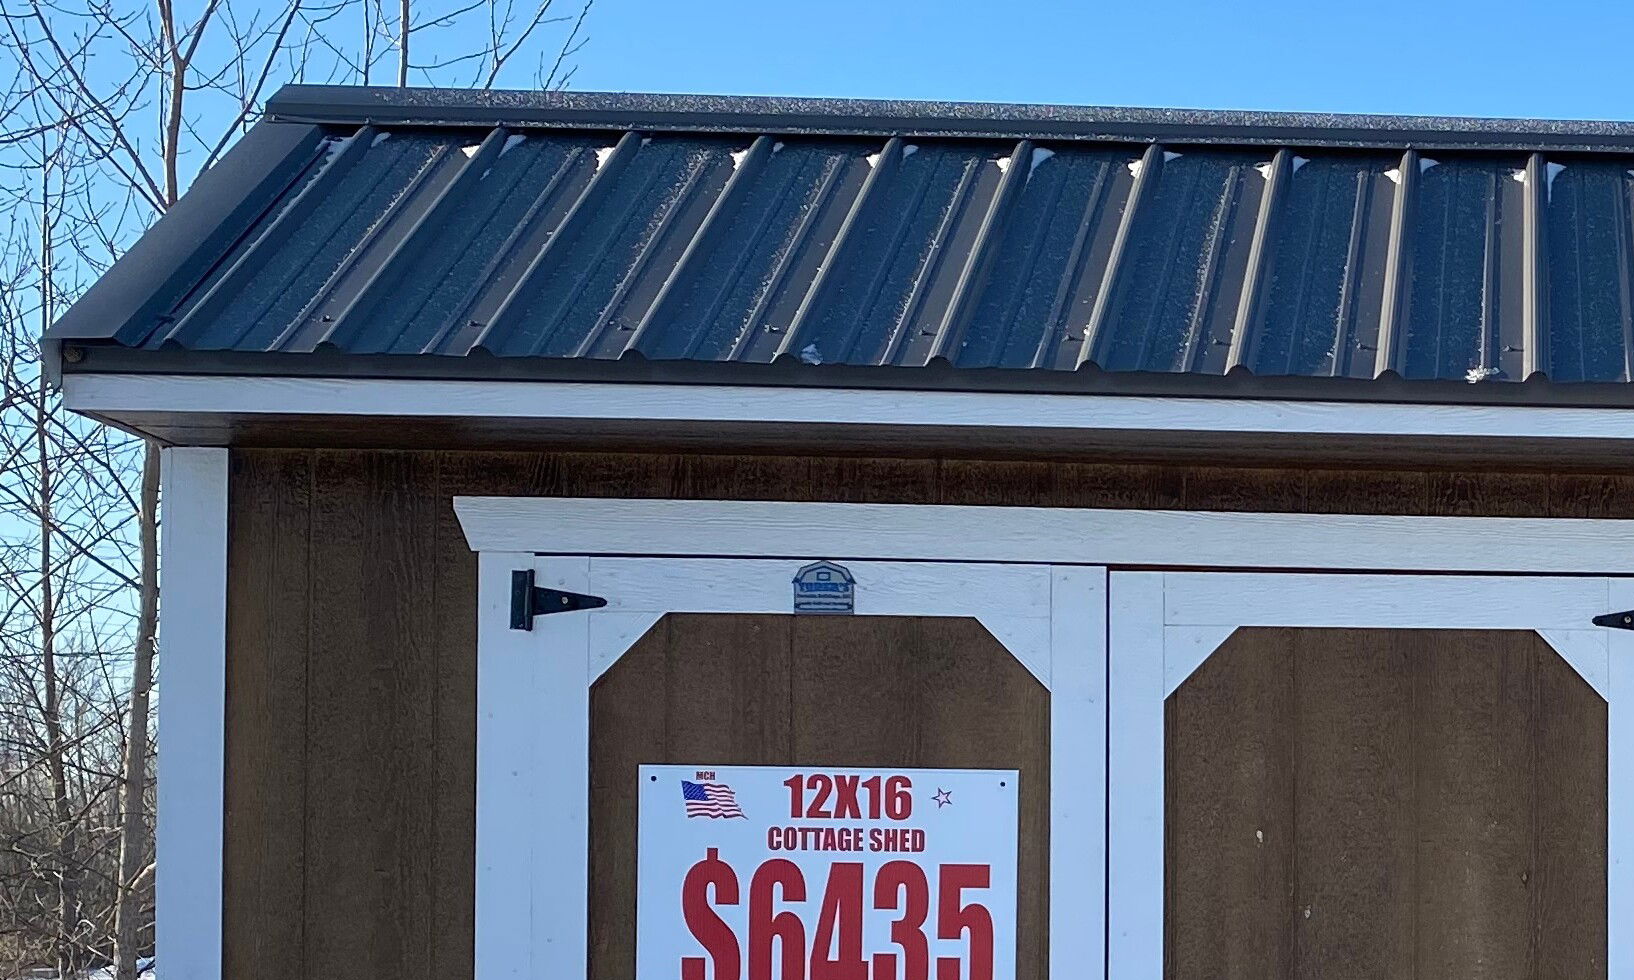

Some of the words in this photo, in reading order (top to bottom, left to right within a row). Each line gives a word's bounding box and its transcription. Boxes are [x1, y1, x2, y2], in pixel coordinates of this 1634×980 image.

[783, 774, 913, 821] 12X16
[767, 826, 864, 852] COTTAGE
[869, 828, 926, 852] SHED
